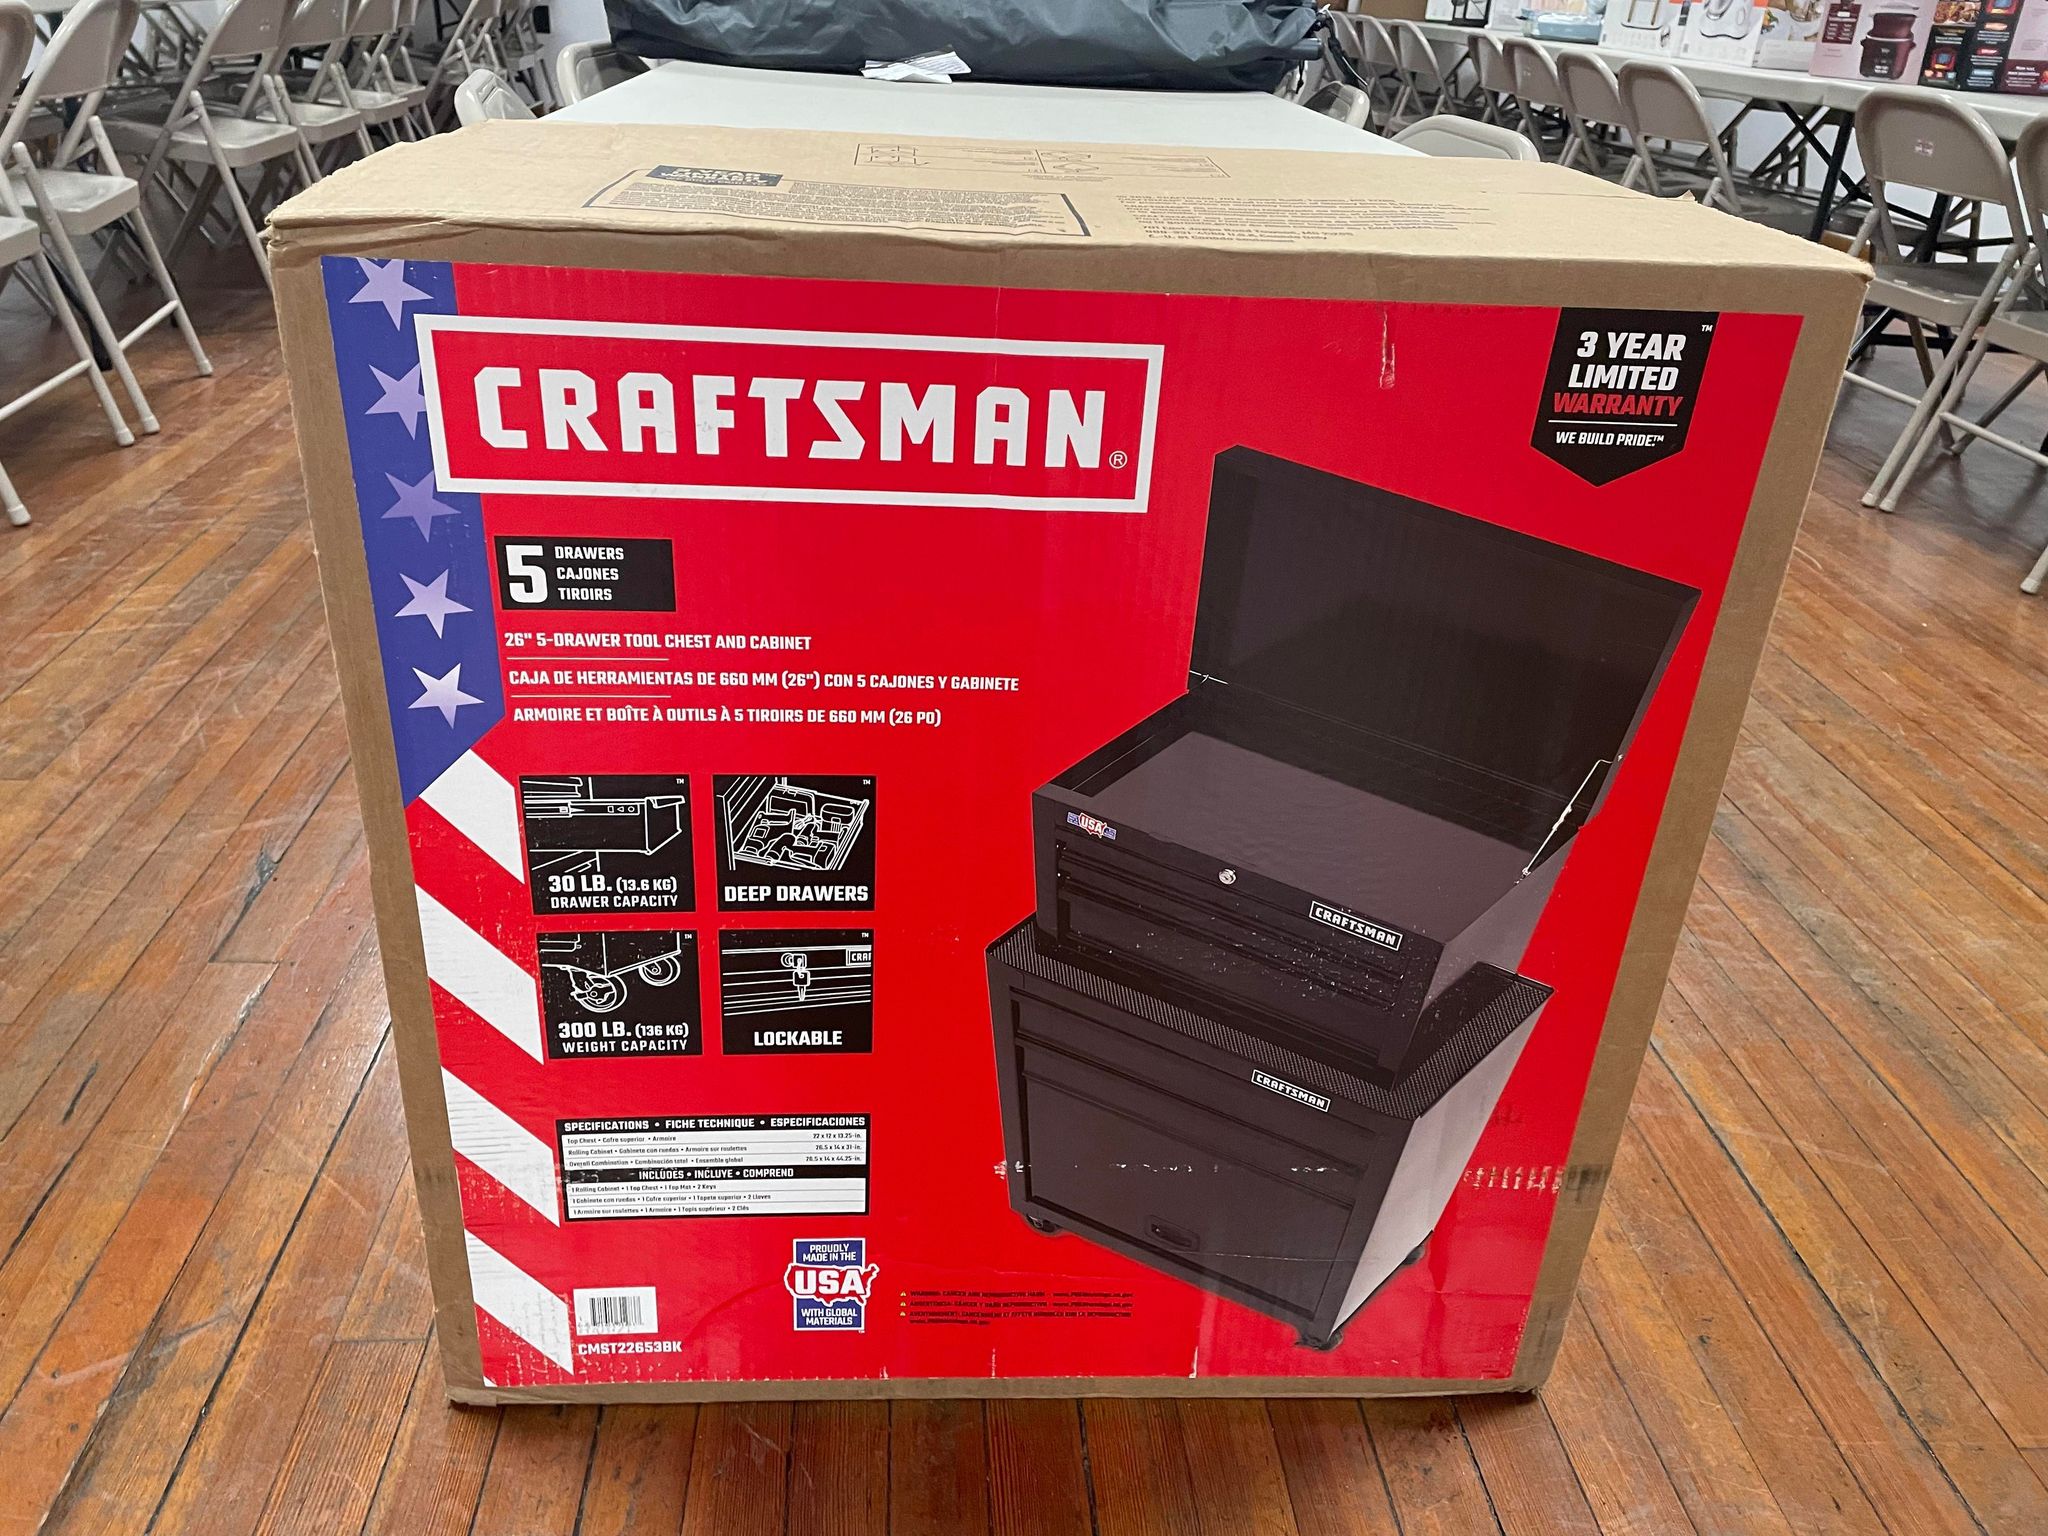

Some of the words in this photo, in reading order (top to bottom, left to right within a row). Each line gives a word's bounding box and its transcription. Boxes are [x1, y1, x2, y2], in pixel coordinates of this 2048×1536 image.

[1577, 331, 1599, 357] 3
[1607, 332, 1687, 361] YEAR
[1568, 364, 1679, 391] LIMITED
[1554, 392, 1684, 417] WARRANTY
[1556, 432, 1576, 444] WE
[1578, 432, 1615, 445] BUILD
[554, 546, 624, 560] DRAWERS
[505, 545, 548, 603] 5
[556, 567, 619, 581] CAJONES
[558, 587, 613, 601] TIROIRS
[536, 632, 621, 648] 5-DRAWER
[624, 633, 662, 648] TOOL
[665, 634, 711, 649] CHEST
[715, 635, 746, 649] AND
[750, 635, 810, 650] CABINET
[509, 671, 550, 685] CAJA
[553, 671, 573, 685] DE
[577, 671, 693, 686] HERRAMIENTAS
[696, 672, 716, 686] DE
[719, 672, 748, 686] 660
[752, 673, 777, 686] MM
[824, 674, 853, 688] CON
[857, 674, 866, 688] 5
[870, 675, 935, 689] CAJONES
[938, 675, 948, 689] Y
[951, 676, 1019, 692] GABINETE
[513, 708, 582, 722] ARMOIRE
[586, 708, 602, 722] ET
[606, 705, 649, 722] BOÎTE
[653, 705, 663, 721] À
[667, 708, 717, 722] OUTILS
[721, 705, 731, 721] À
[734, 708, 744, 722] 5
[747, 708, 803, 722] TIROIRS
[807, 710, 825, 723] DE
[829, 709, 857, 723] 660
[861, 710, 885, 724] MM
[889, 708, 913, 727] (26
[917, 709, 941, 727] PO)
[1082, 816, 1102, 834] USA
[548, 875, 575, 893] 30
[580, 875, 613, 892] LB.
[616, 878, 649, 895] (13.6
[652, 876, 677, 892] KG)
[724, 886, 772, 902] DEEP
[775, 886, 869, 902] DRAWERS
[550, 895, 609, 910] DRAWER
[613, 894, 678, 908] CAPACITY
[1315, 907, 1396, 946] CRAFTSMAN
[558, 1022, 598, 1039] 300
[602, 1022, 632, 1038] LB.
[635, 1025, 662, 1039] (136
[666, 1022, 689, 1038] KG)
[754, 1030, 843, 1046] LOCKABLE
[562, 1041, 616, 1053] WEIGHT
[621, 1039, 688, 1052] CAPACITY
[1256, 1073, 1325, 1108] CRAFTSMAN
[564, 1120, 650, 1132] SPECIFICATIONS
[665, 1119, 695, 1129] FICHE
[698, 1118, 755, 1129] TECHNIQUE
[770, 1117, 865, 1127] ESPECIFICACIONES
[639, 1169, 684, 1180] INCLUDES
[694, 1169, 733, 1179] INCLUYE
[743, 1168, 794, 1178] COMPREND
[810, 1243, 849, 1253] PROUDLY
[803, 1253, 828, 1262] MADE
[829, 1252, 839, 1261] IN
[840, 1252, 856, 1261] THE
[795, 1270, 865, 1294] USA
[801, 1309, 824, 1317] WITH
[826, 1308, 857, 1317] GLOBAL
[806, 1317, 853, 1326] MATERIALS
[578, 1341, 683, 1355] CMST22653BK
